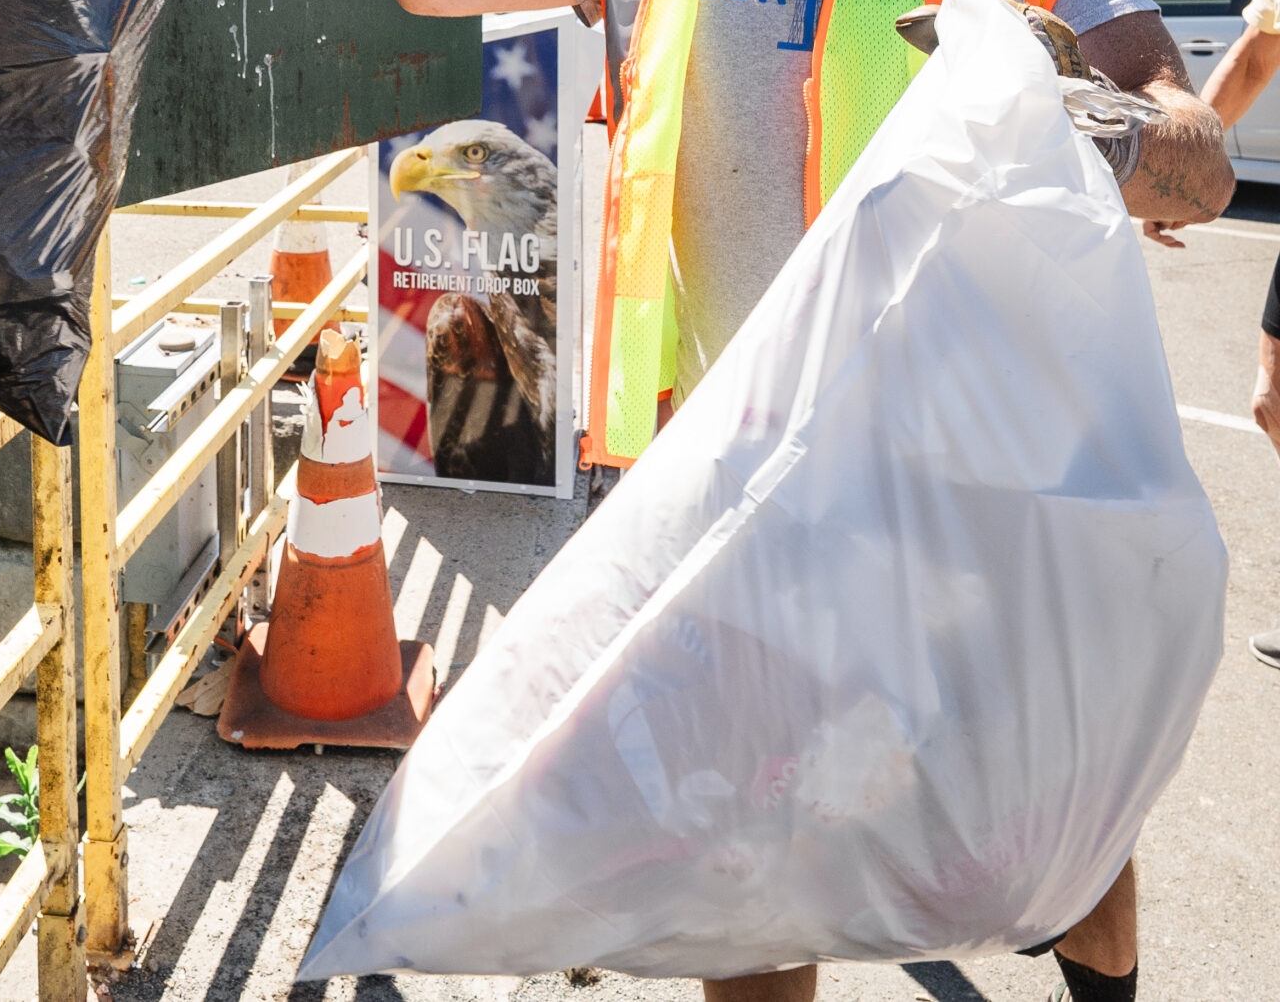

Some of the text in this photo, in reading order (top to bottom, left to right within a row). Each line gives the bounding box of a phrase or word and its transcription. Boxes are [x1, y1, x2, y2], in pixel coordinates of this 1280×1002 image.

[394, 227, 540, 273] U.S. FLAG
[393, 271, 540, 296] RETIREMENT DROP BOX
